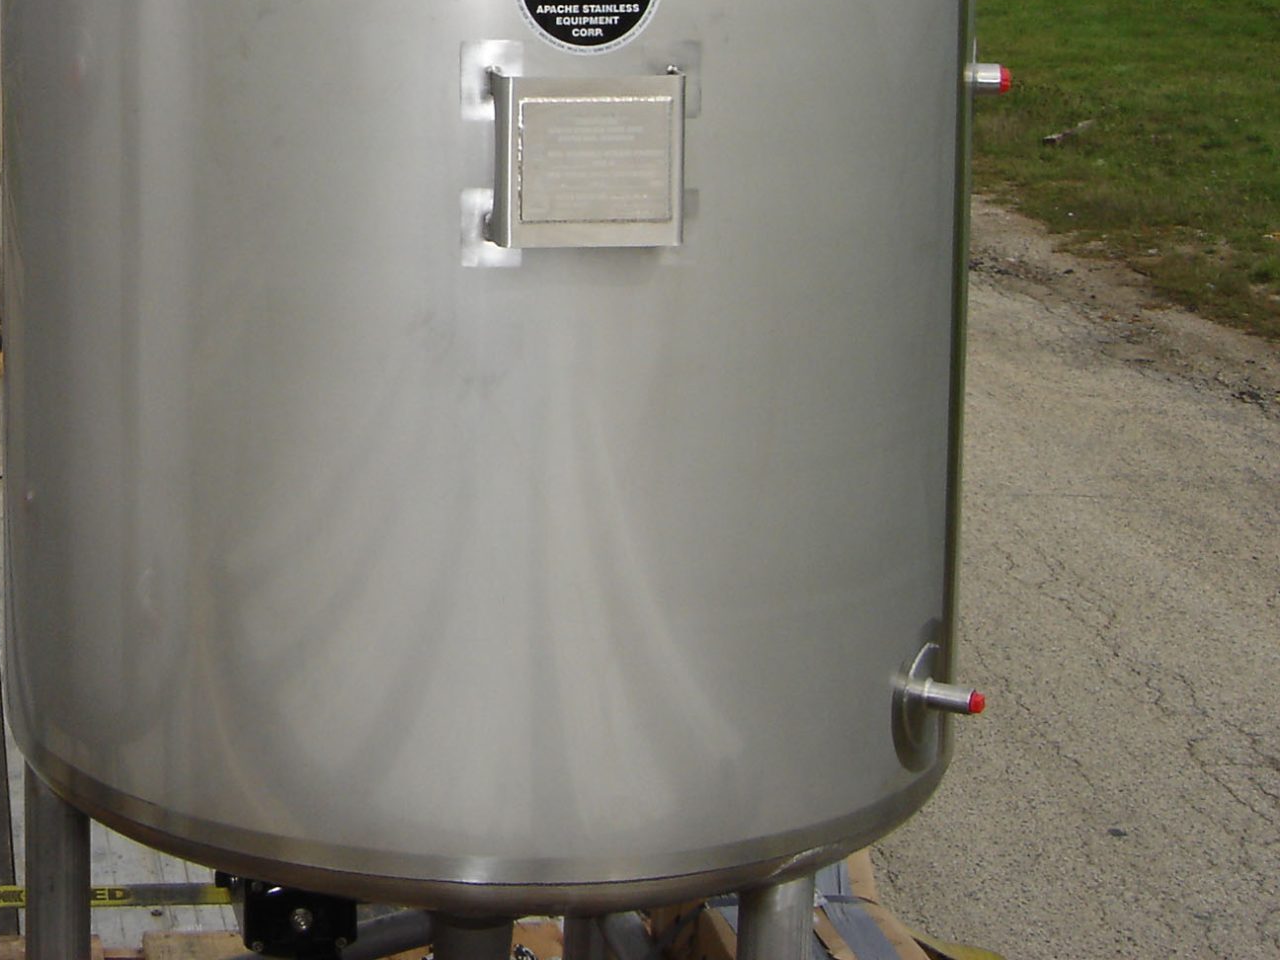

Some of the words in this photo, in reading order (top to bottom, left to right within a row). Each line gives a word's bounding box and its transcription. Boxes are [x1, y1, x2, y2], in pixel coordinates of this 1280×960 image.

[536, 5, 580, 14] APACHE
[582, 3, 640, 13] STAINLESS
[556, 16, 620, 25] EQUIPMENT
